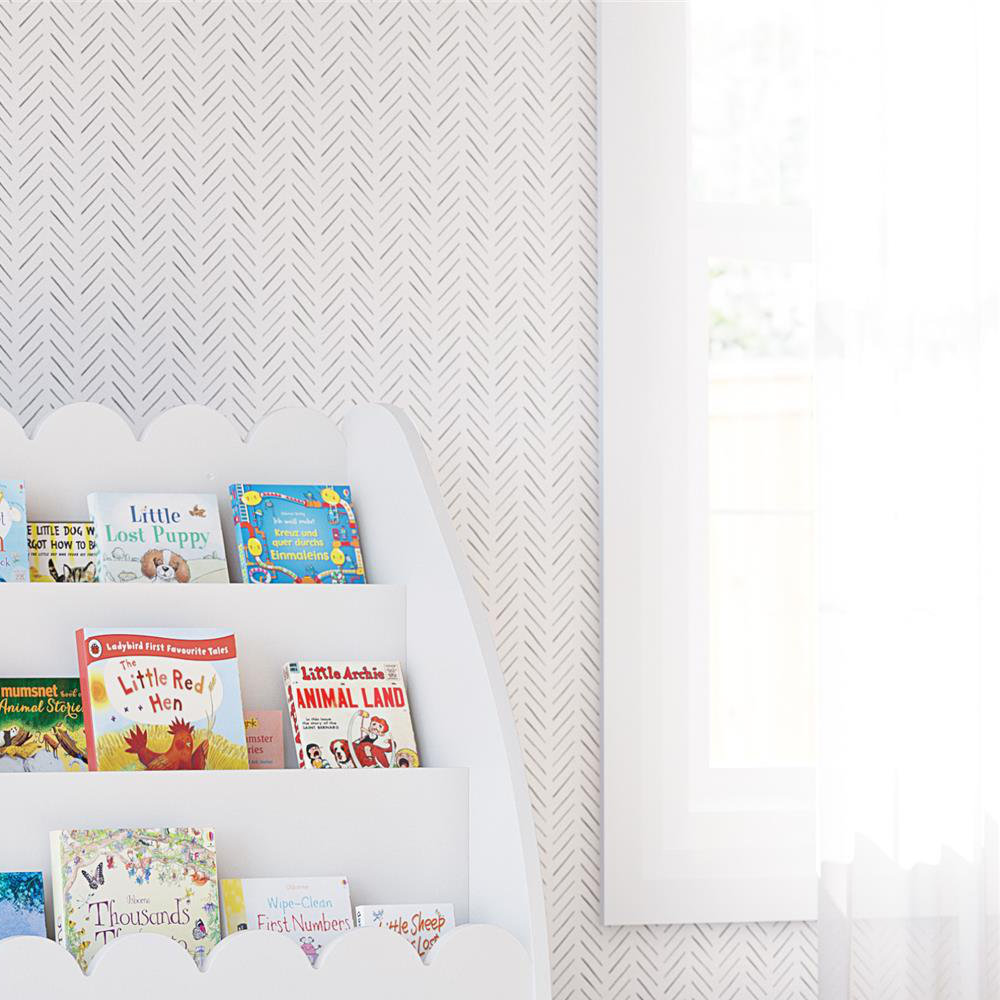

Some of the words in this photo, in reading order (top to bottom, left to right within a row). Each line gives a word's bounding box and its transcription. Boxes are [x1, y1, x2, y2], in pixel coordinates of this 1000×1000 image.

[130, 504, 181, 524] Little
[36, 525, 60, 536] LITTLE
[63, 525, 83, 536] DOG
[104, 523, 147, 543] Lost
[151, 524, 211, 550] Puppy
[27, 539, 48, 551] RGOT
[50, 539, 73, 550] HOW
[75, 540, 87, 550] TO
[269, 548, 330, 561] Einmaleins
[105, 641, 144, 653] Ladybird
[145, 641, 165, 652] First
[166, 645, 207, 656] Favourite
[207, 645, 229, 656] Tales
[119, 657, 137, 671] The
[116, 666, 168, 696] Little
[172, 668, 206, 695] Red
[300, 665, 341, 681] Little
[342, 665, 386, 680] Archie
[0, 684, 58, 698] mumsnet
[296, 687, 359, 709] ANIMAL
[360, 687, 406, 708] LAND
[148, 692, 183, 714] Hen
[247, 735, 274, 743] mster
[248, 746, 264, 754] ries
[88, 897, 191, 927] Thousands
[267, 895, 334, 914] Wipe-Clean
[257, 913, 291, 933] First
[291, 911, 352, 932] Numbers
[379, 916, 409, 935] ttle
[410, 911, 446, 936] Sheep
